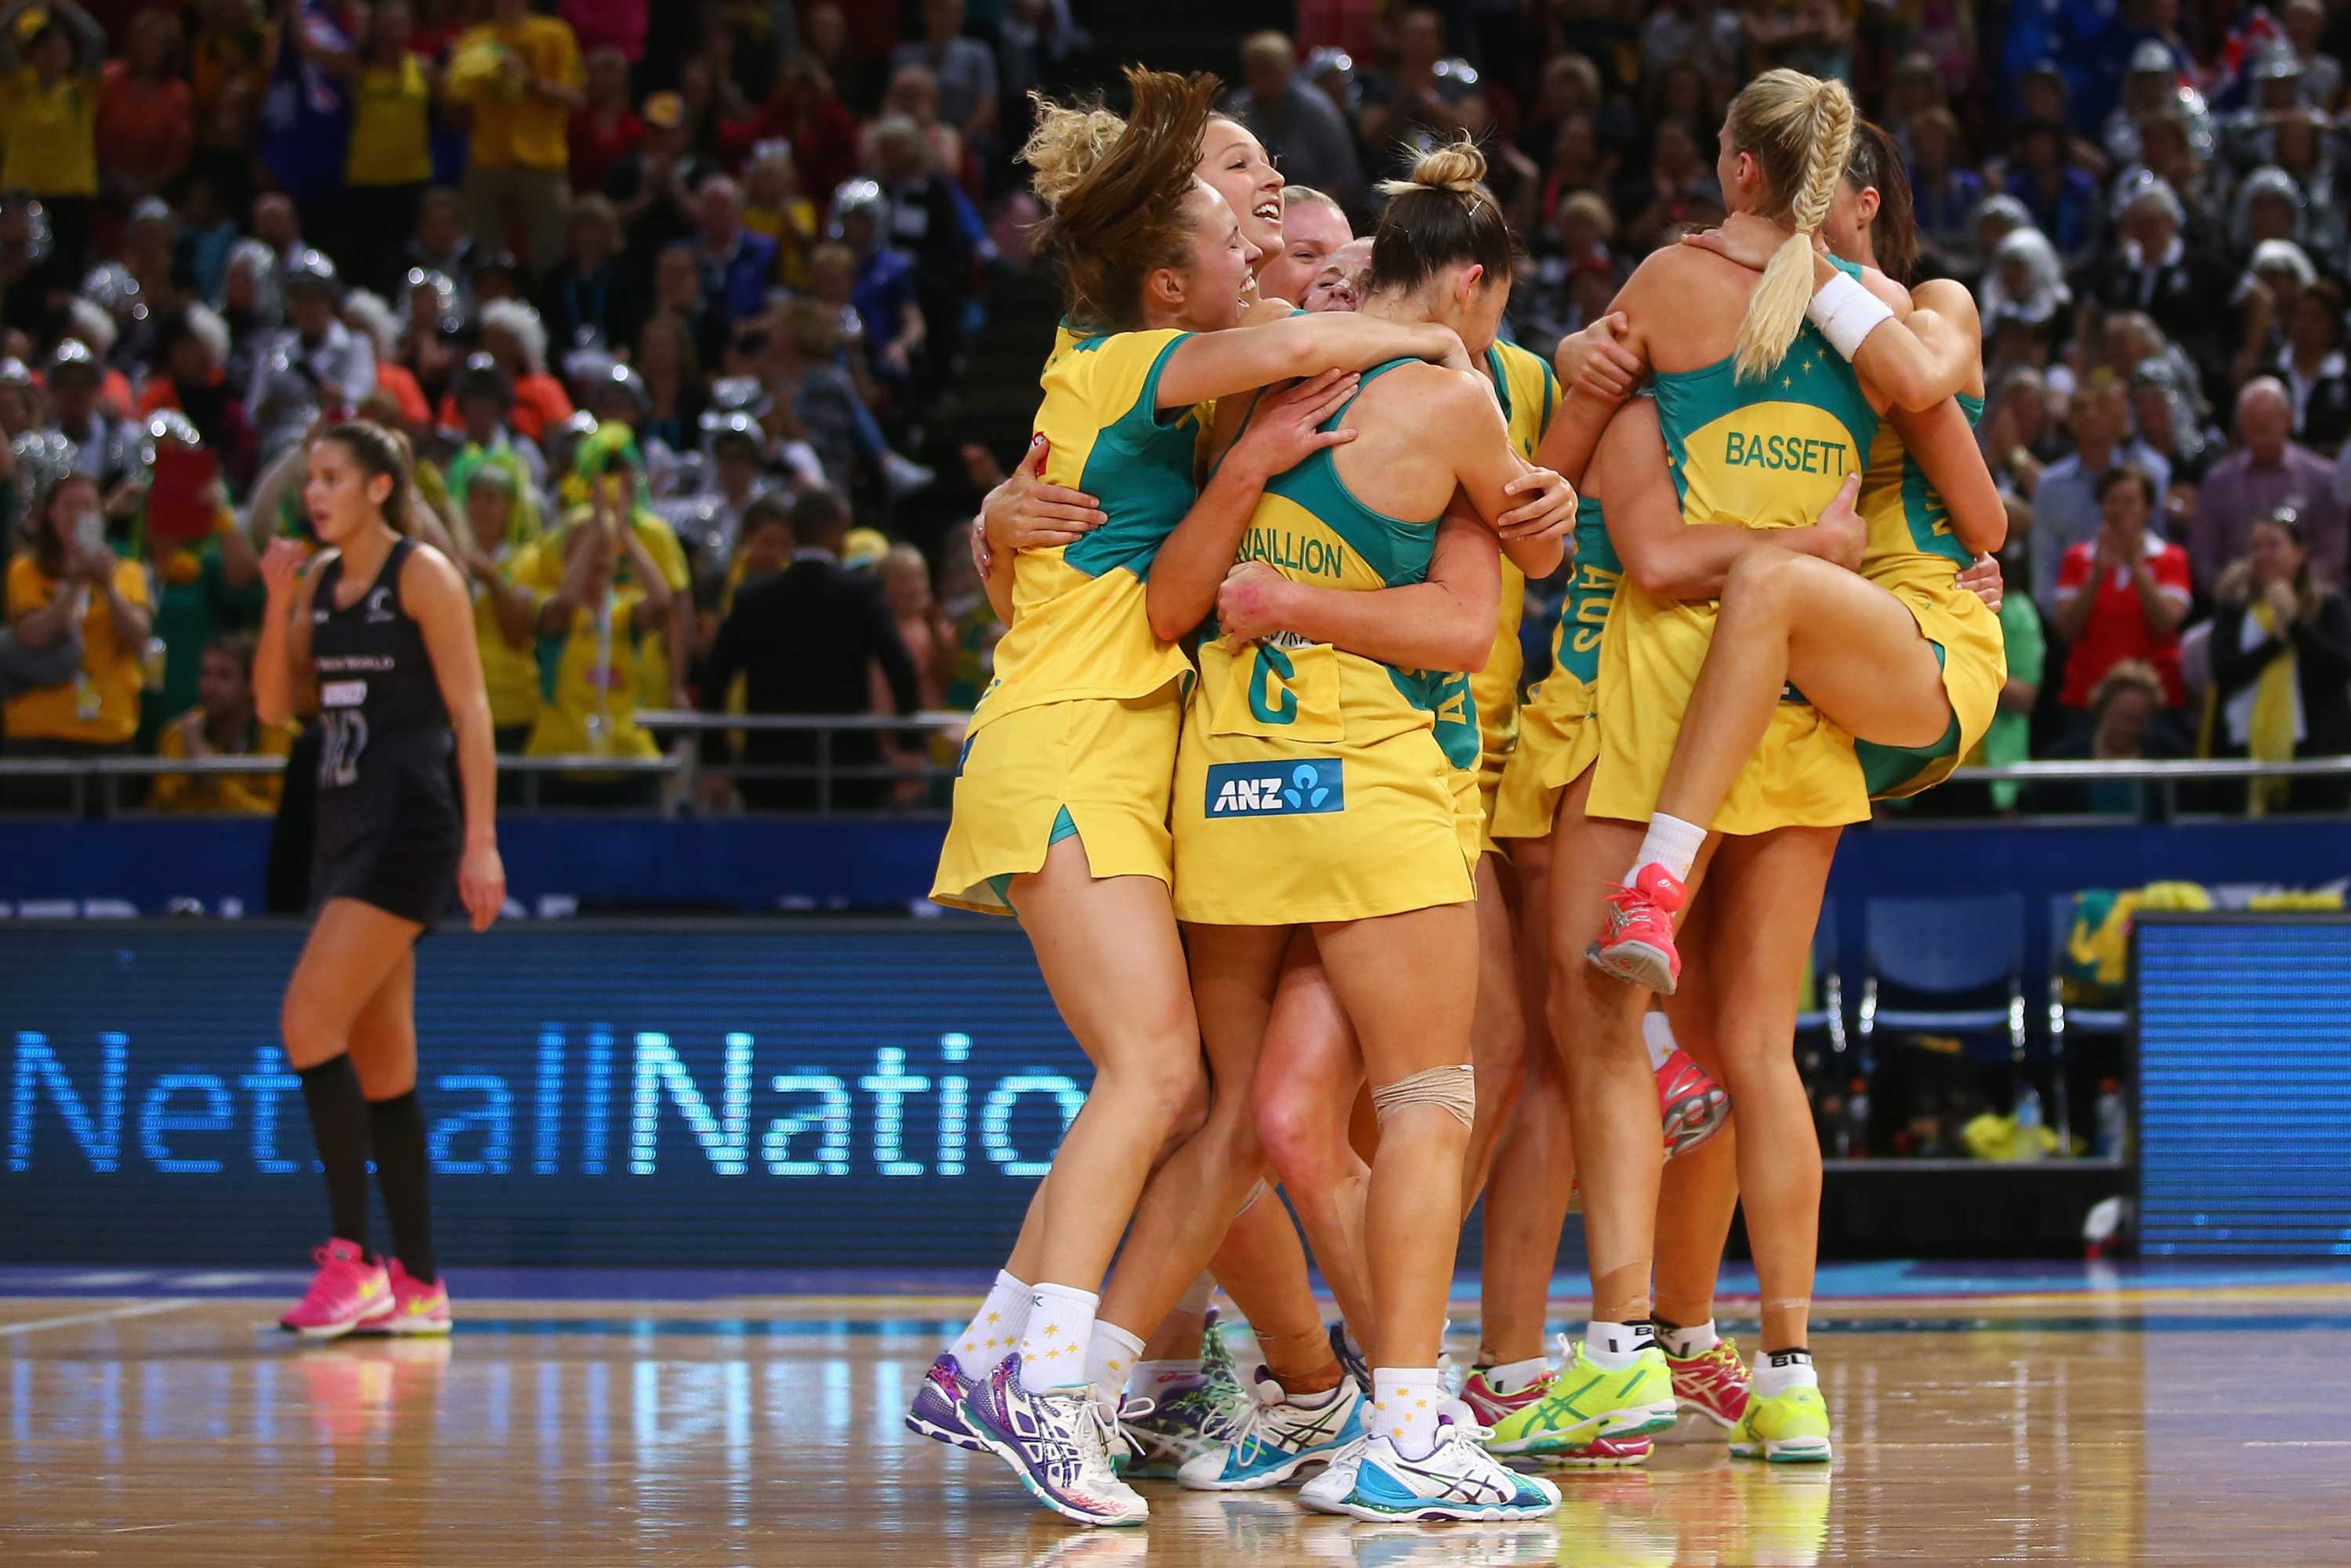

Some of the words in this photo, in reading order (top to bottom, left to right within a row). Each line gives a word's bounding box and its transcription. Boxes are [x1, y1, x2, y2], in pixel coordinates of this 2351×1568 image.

[1726, 432, 1846, 477] BASSETT
[1237, 528, 1342, 578] VAILLION
[1213, 778, 1283, 812] ANZ
